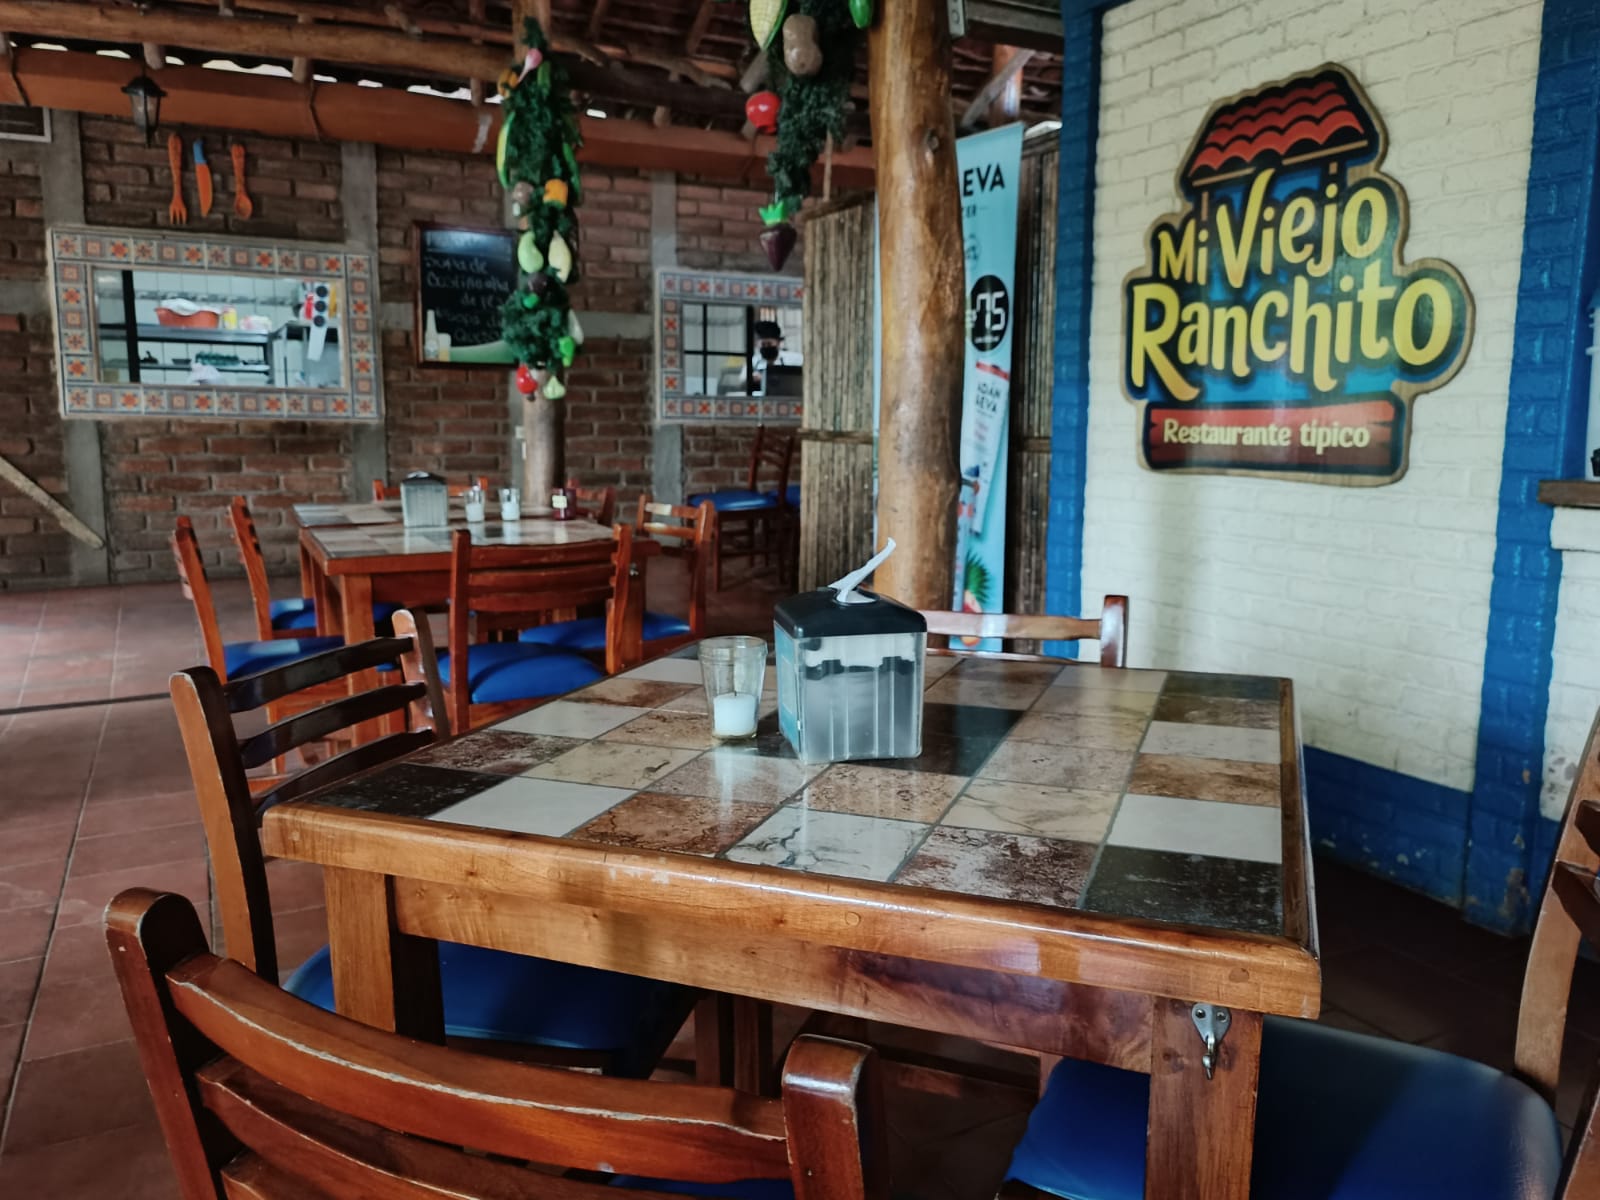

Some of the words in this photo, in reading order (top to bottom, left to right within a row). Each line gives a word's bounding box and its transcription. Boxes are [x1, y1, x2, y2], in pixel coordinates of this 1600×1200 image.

[963, 163, 1006, 198] EVA
[1158, 218, 1208, 286] Mi
[1216, 168, 1388, 289] Viejo
[1131, 259, 1453, 401] Ranchito
[1163, 418, 1291, 447] Restaurante
[1300, 417, 1370, 454] típico
